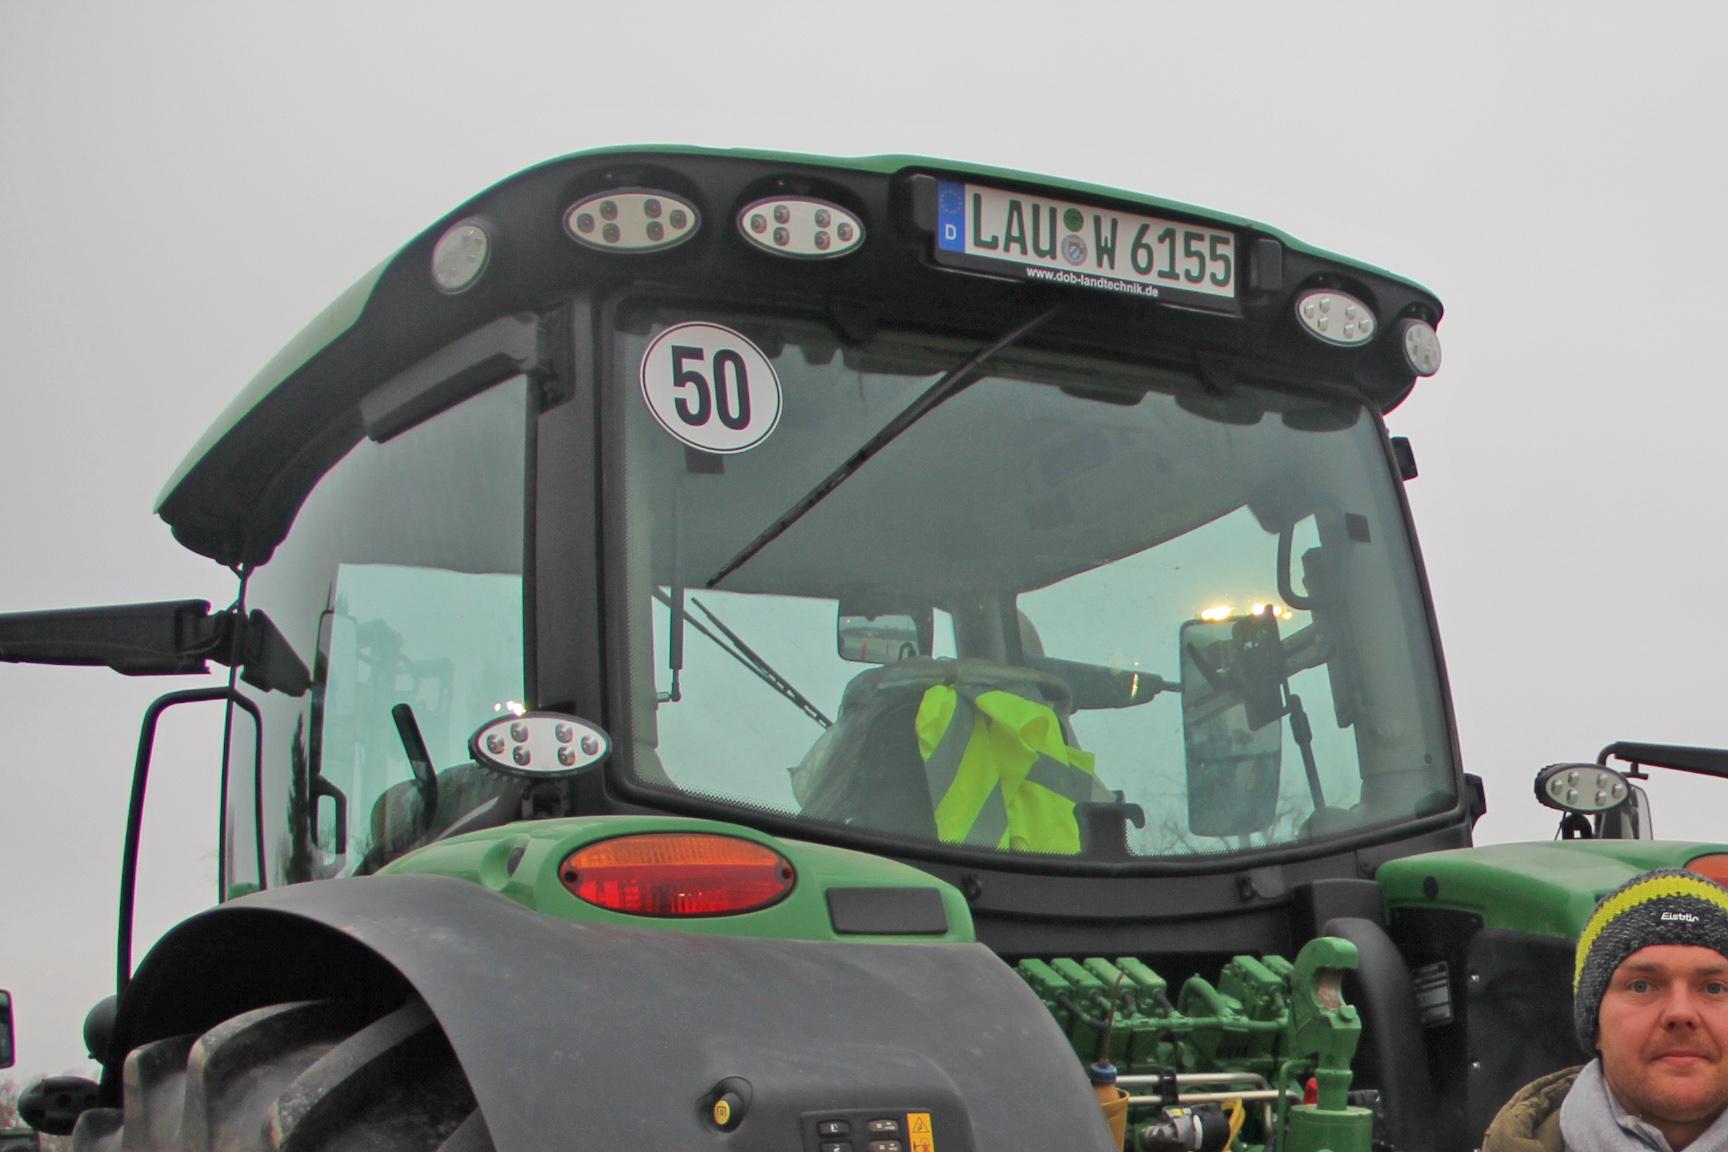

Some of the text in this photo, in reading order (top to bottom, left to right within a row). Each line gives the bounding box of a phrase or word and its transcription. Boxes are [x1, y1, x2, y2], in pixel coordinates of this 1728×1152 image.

[945, 193, 1232, 287] D LAU W 6155
[1026, 265, 1159, 297] www.dob-landtechnik.de
[671, 344, 751, 431] 50
